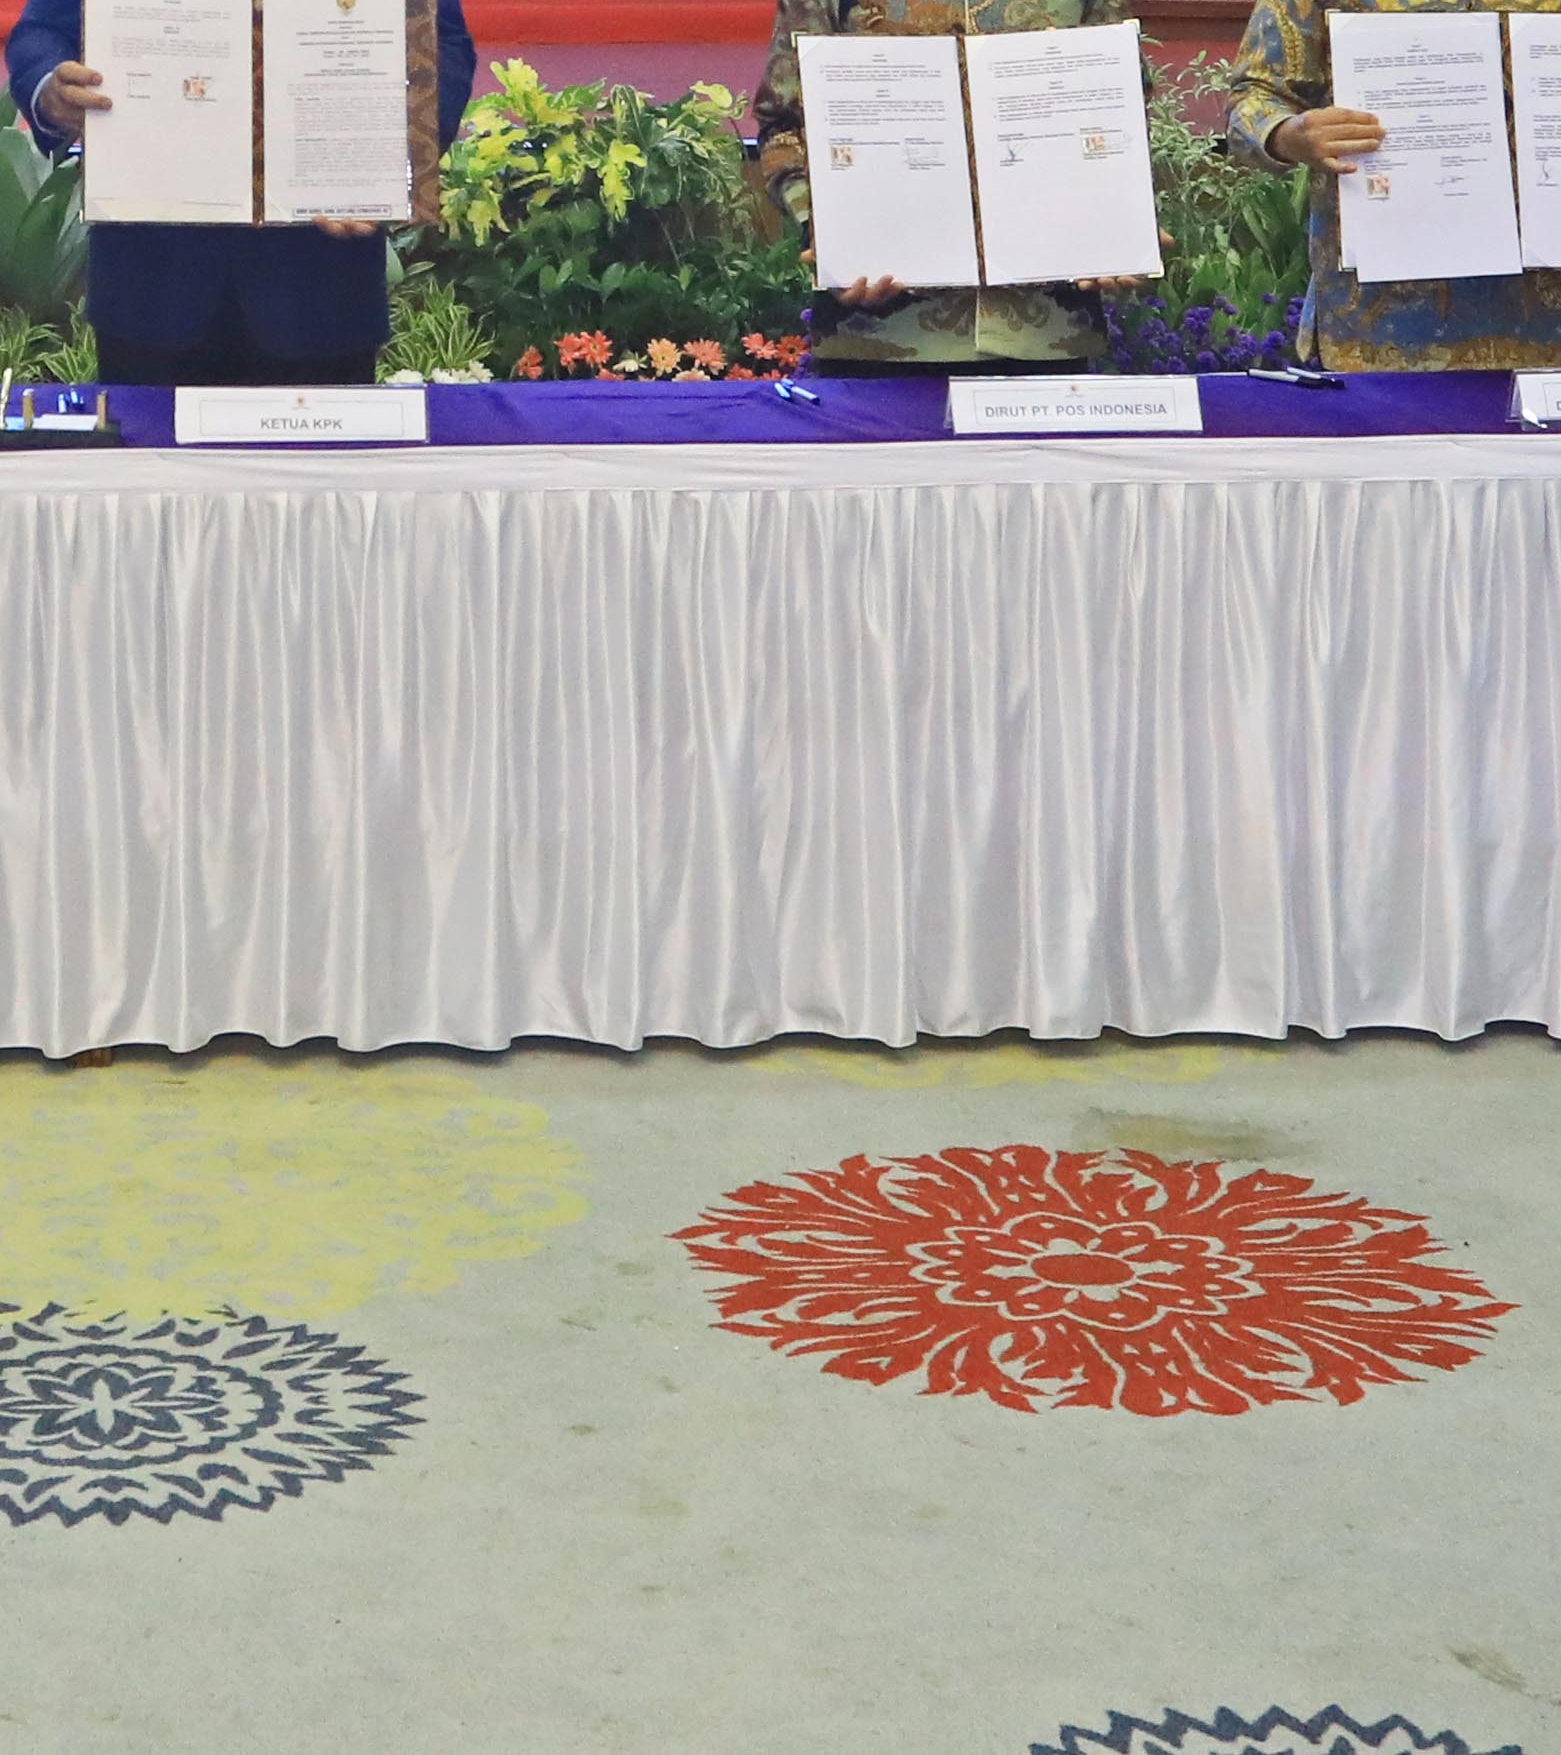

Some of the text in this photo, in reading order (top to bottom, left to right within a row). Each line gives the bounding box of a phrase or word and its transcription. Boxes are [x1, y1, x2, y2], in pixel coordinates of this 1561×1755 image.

[985, 406, 1027, 418] DIRUT
[1056, 405, 1085, 416] POS
[1089, 403, 1167, 416] INDONESIA
[260, 418, 343, 430] KETUA KPK
